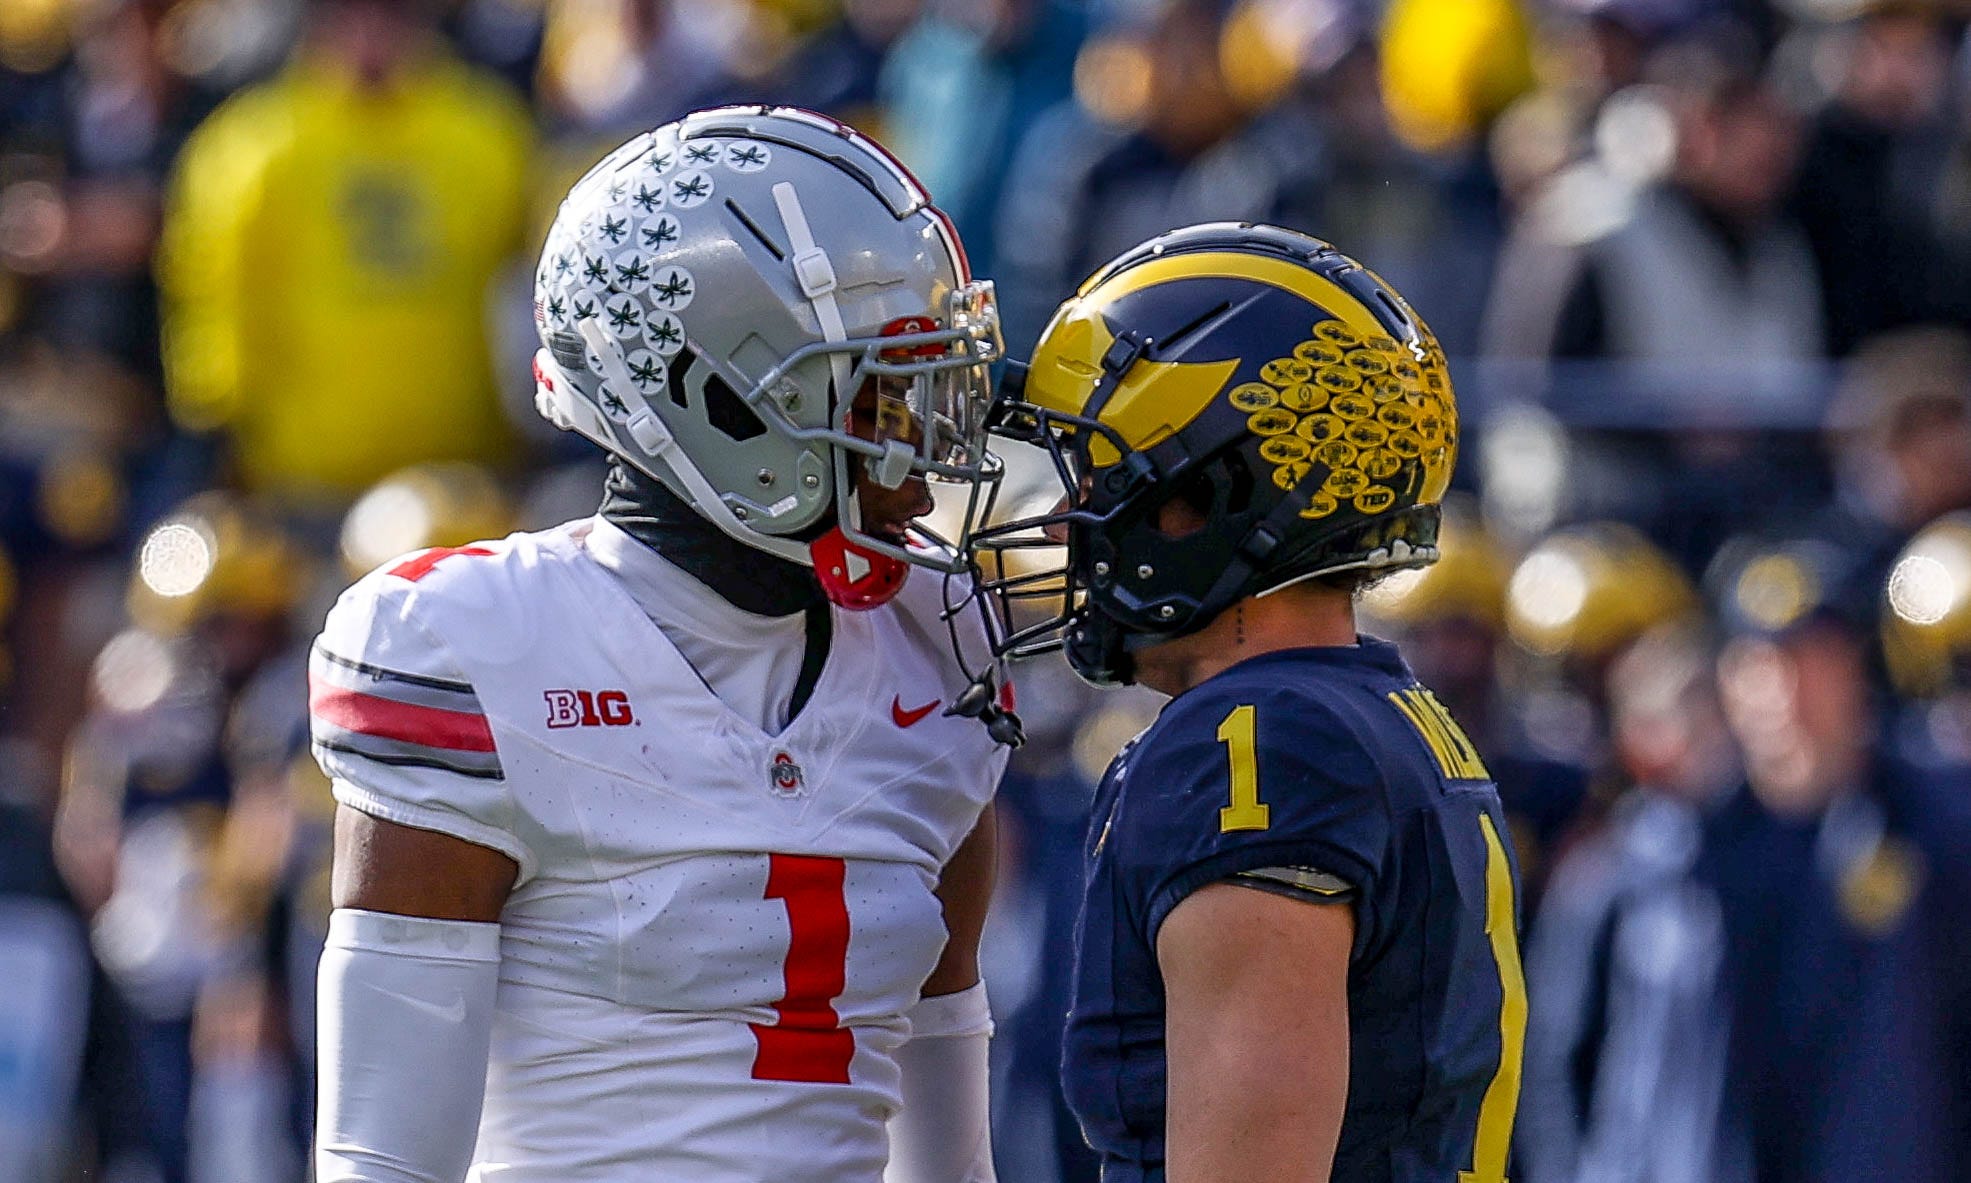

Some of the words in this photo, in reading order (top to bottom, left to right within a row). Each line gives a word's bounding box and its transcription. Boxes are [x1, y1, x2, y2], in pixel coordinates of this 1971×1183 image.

[1217, 704, 1270, 834] 1
[747, 852, 856, 1085] 1
[1456, 814, 1530, 1183] 1
